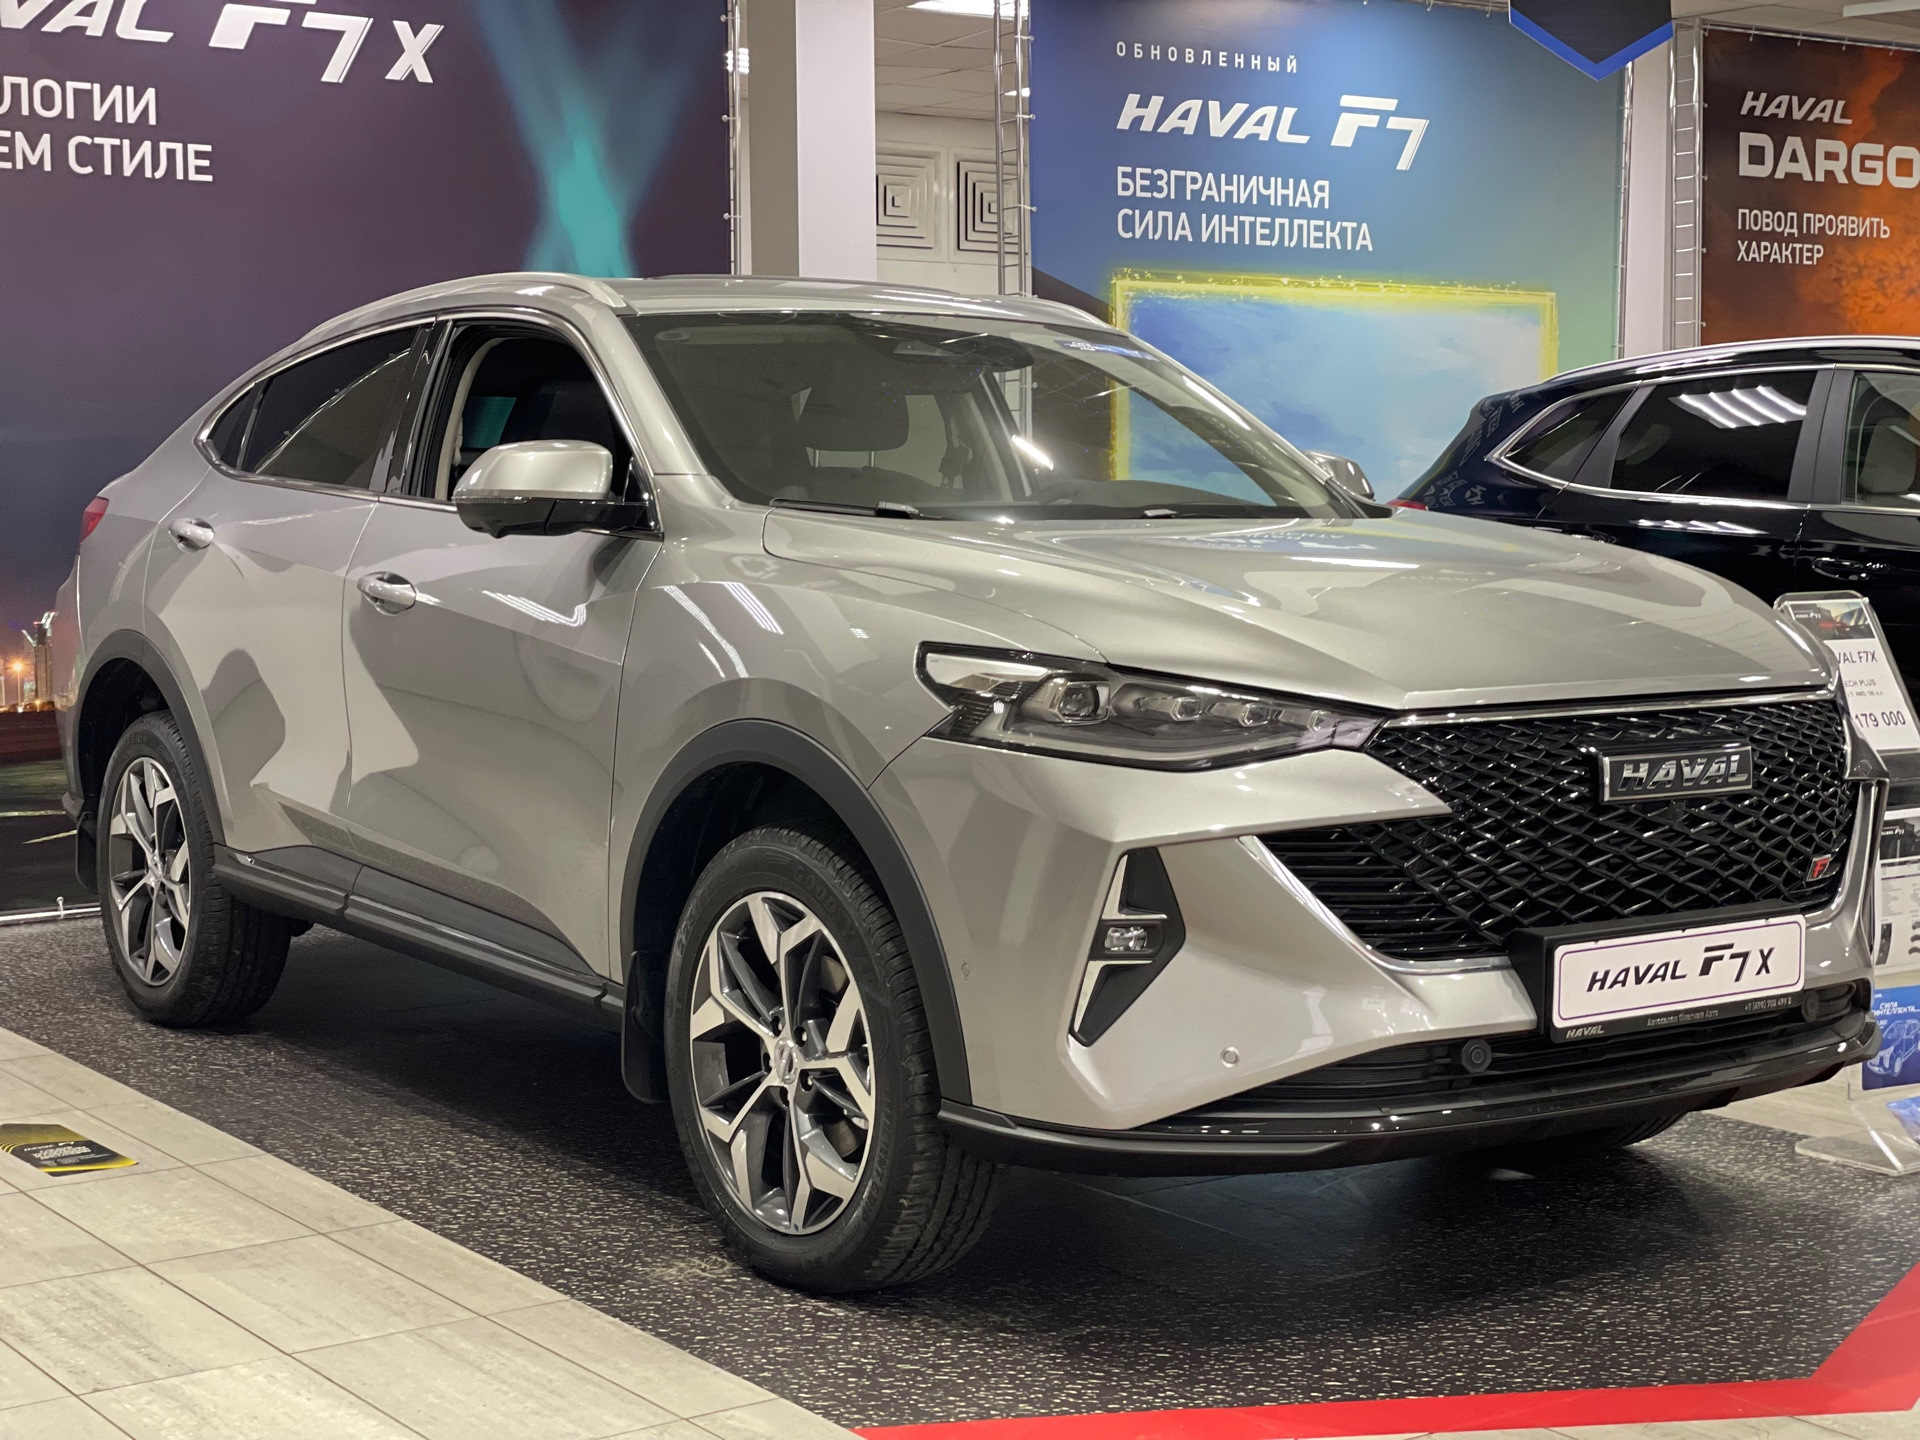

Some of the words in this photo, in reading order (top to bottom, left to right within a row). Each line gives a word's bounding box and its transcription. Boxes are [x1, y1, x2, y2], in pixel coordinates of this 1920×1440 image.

[1116, 41, 1298, 73] ОБНОВЛЕННЫЙ
[0, 75, 157, 125] ЛОГИИ
[1740, 91, 1853, 125] HAVAL
[1116, 93, 1311, 144] HAVAL
[1330, 94, 1429, 171] F7
[67, 135, 213, 182] СТИЛЕ
[1739, 131, 1920, 189] DARGO
[1116, 166, 1330, 209] БЕЗГРАНИЧНАЯ
[1117, 208, 1193, 242] СИЛА
[1201, 213, 1373, 251] ИНТЕЛЛЕКТА
[1737, 208, 1798, 237] ПОВОД
[1802, 213, 1891, 239] ПРОЯВИТЬ
[1737, 240, 1824, 265] ХАРАКТЕР
[1857, 650, 1878, 663] F7X
[1881, 711, 1906, 726] 000
[1617, 754, 1748, 791] HAVAL
[1586, 960, 1688, 992] HAVAL
[1566, 1025, 1605, 1039] HAVAL
